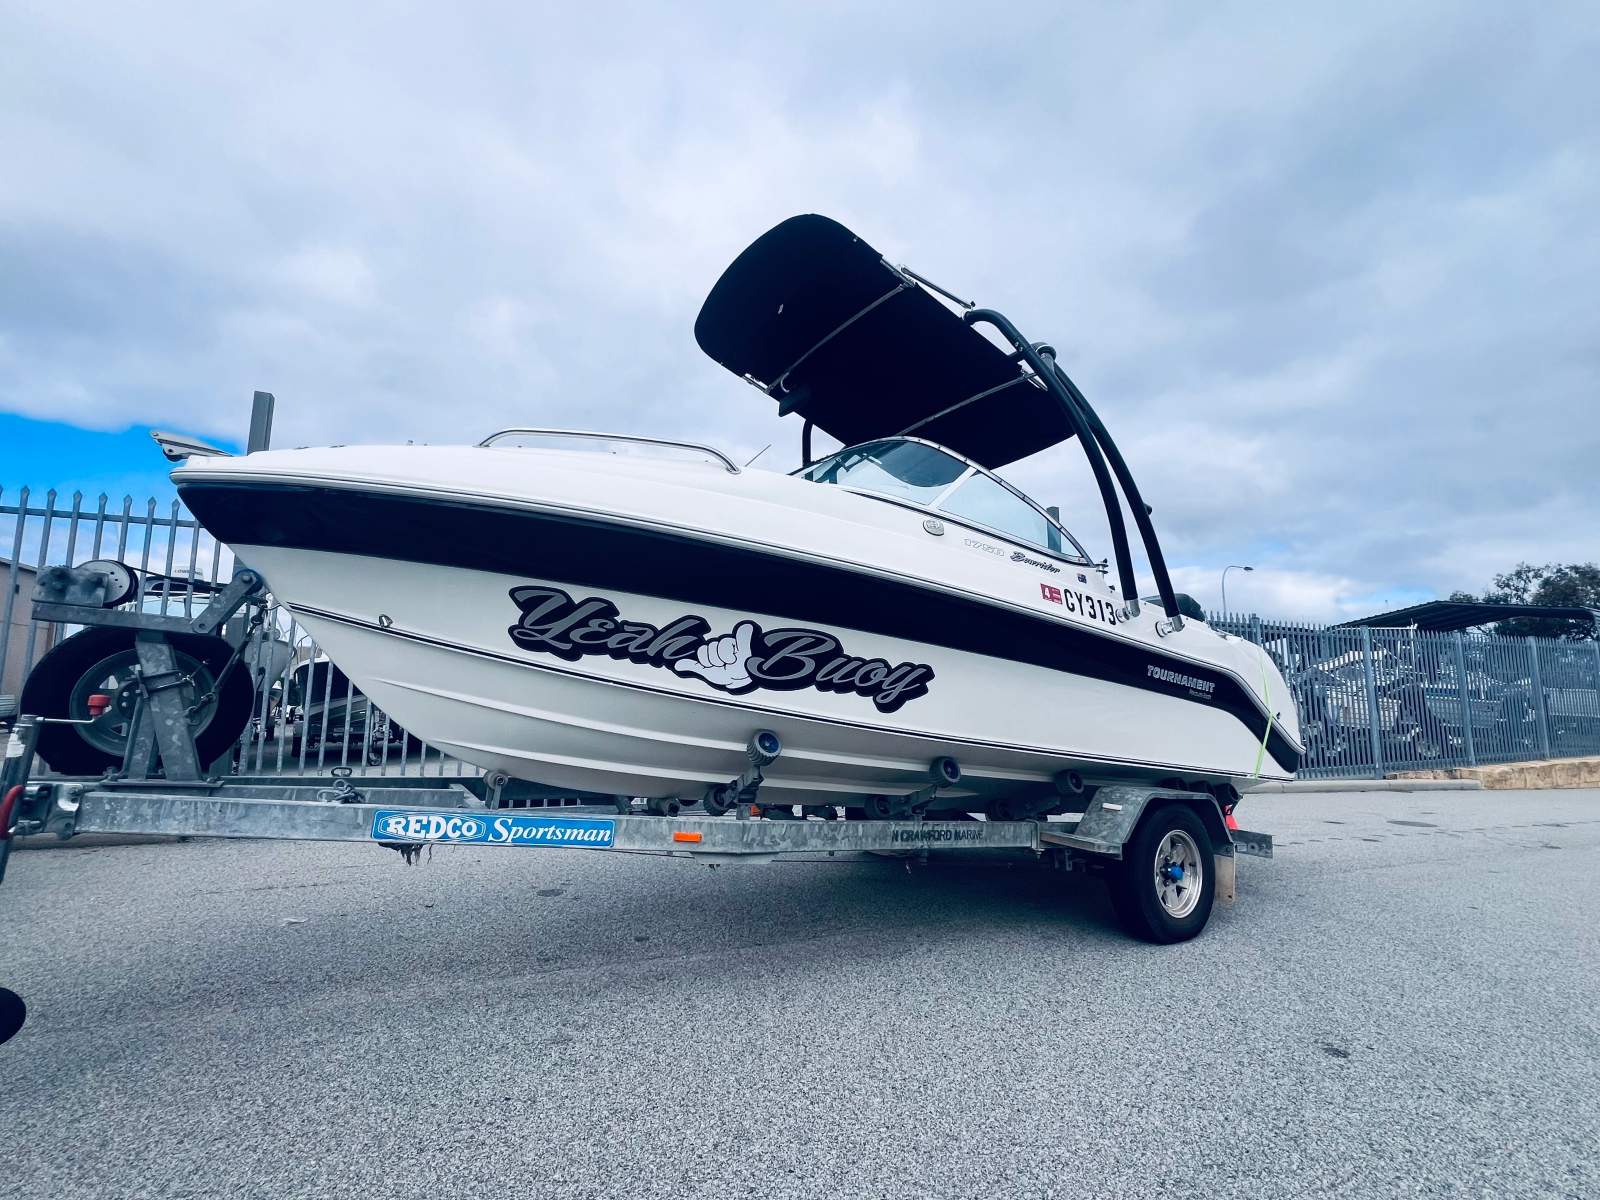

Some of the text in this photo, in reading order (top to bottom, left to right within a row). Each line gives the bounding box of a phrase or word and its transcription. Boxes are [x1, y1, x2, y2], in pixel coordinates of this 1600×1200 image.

[1010, 551, 1060, 574] Bowrider
[510, 587, 931, 708] Yeah Buoy
[1147, 664, 1216, 693] TOURNAMENT
[488, 818, 611, 843] Sportsman
[953, 829, 984, 841] MARINE
